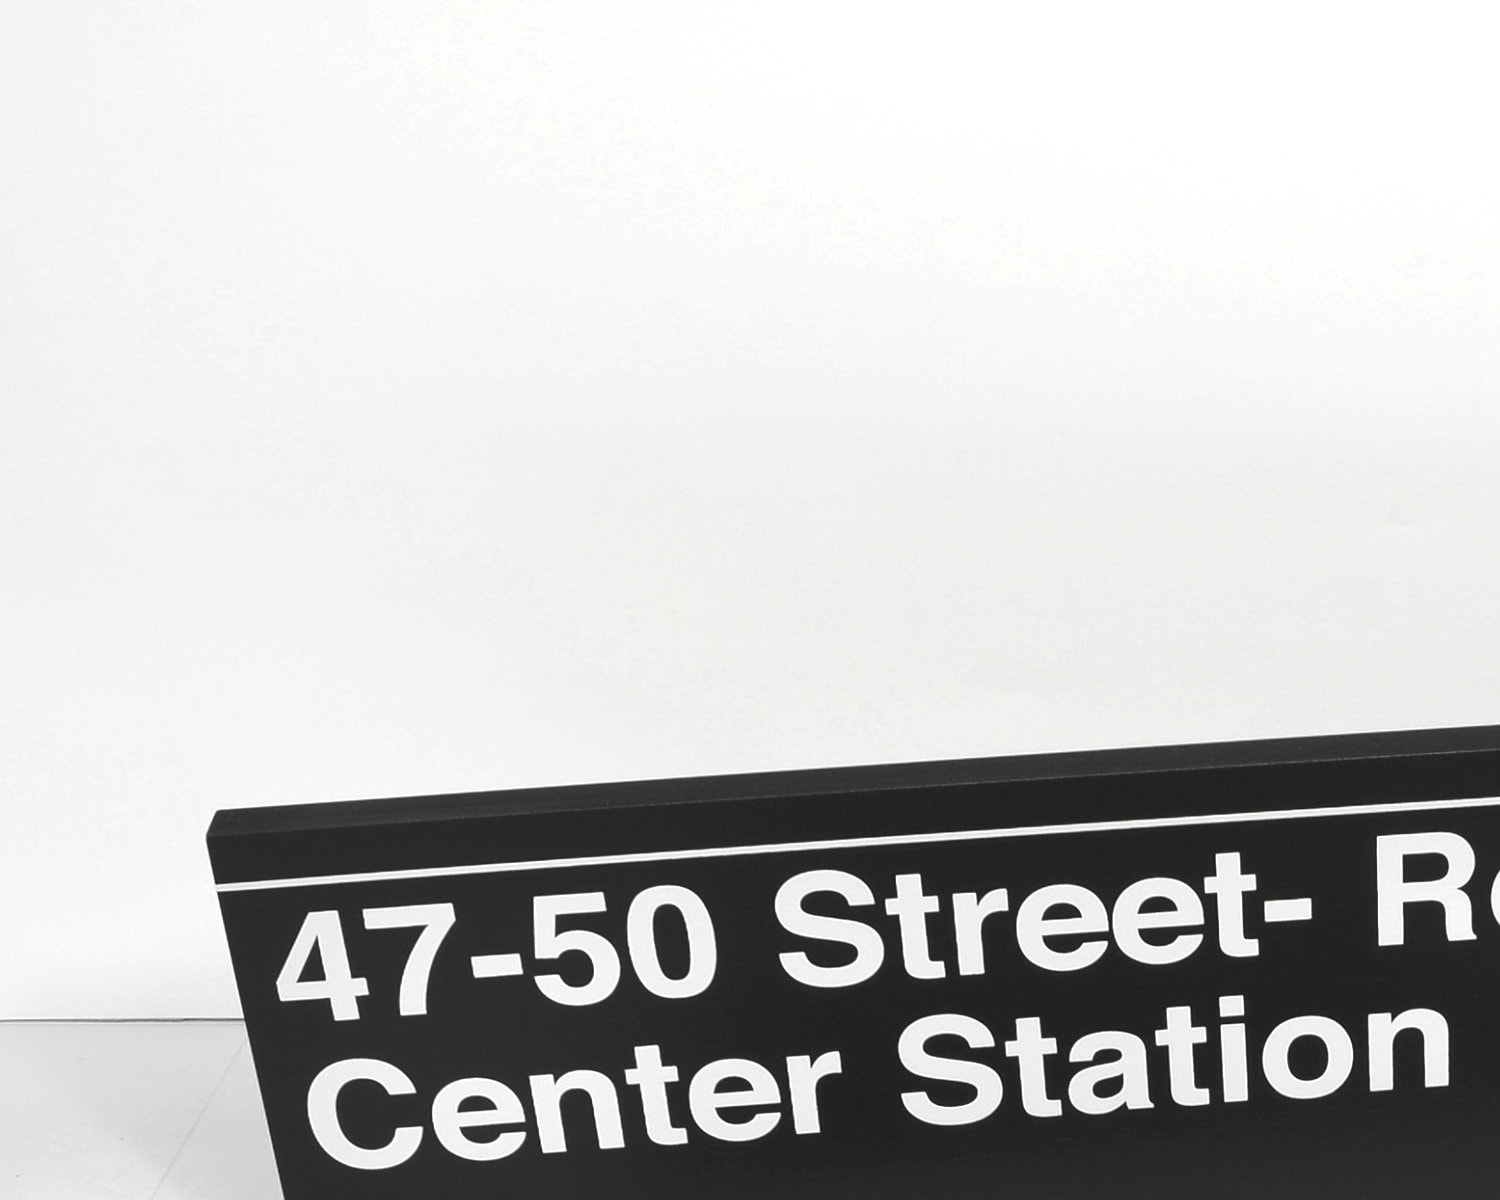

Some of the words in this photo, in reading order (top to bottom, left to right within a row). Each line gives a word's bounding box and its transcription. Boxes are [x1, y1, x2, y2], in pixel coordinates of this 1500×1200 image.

[276, 885, 718, 1022] 47-50
[775, 852, 1313, 988] Street-
[307, 1044, 843, 1170] Center
[898, 995, 1449, 1126] Station
